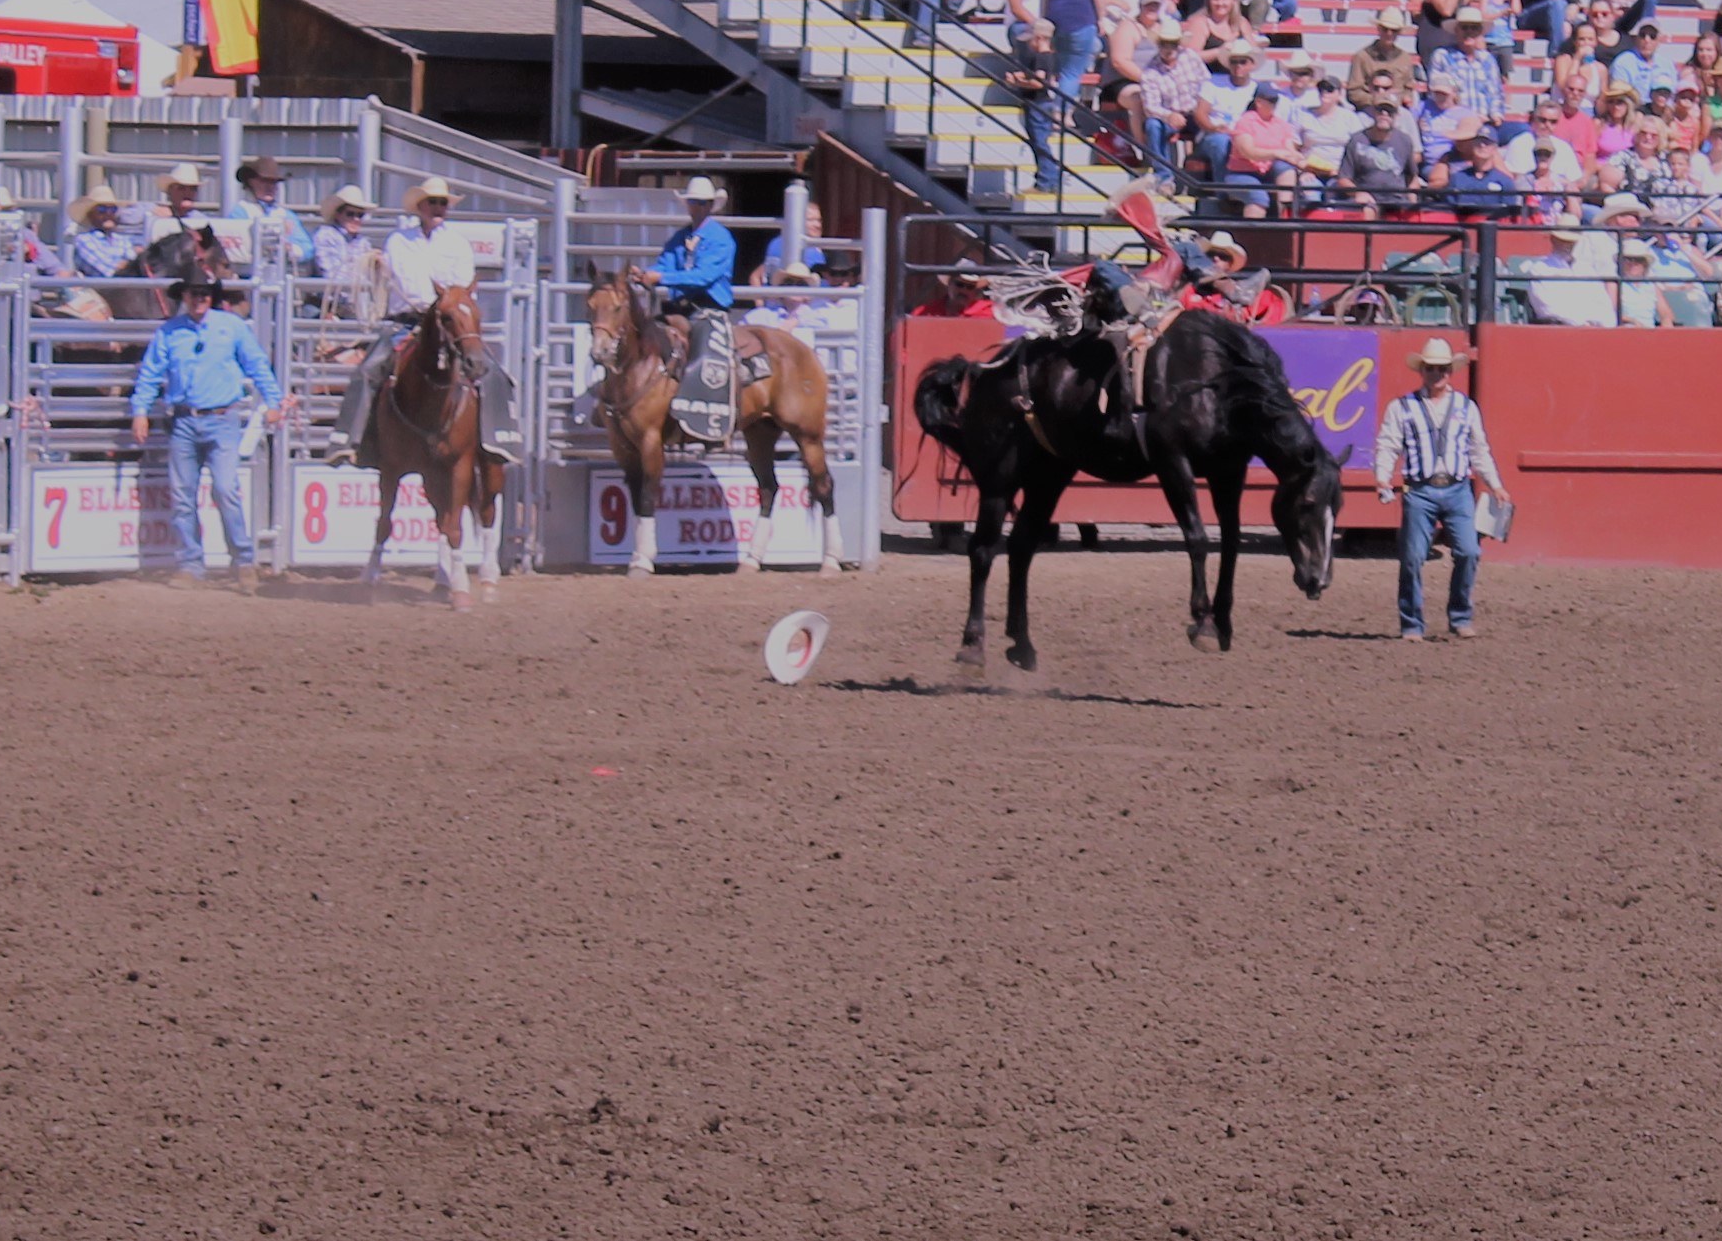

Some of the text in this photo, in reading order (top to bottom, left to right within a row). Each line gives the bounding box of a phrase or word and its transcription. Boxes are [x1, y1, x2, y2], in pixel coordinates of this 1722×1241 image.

[43, 487, 68, 549] 7
[303, 481, 328, 544] 8
[600, 485, 627, 546] 9
